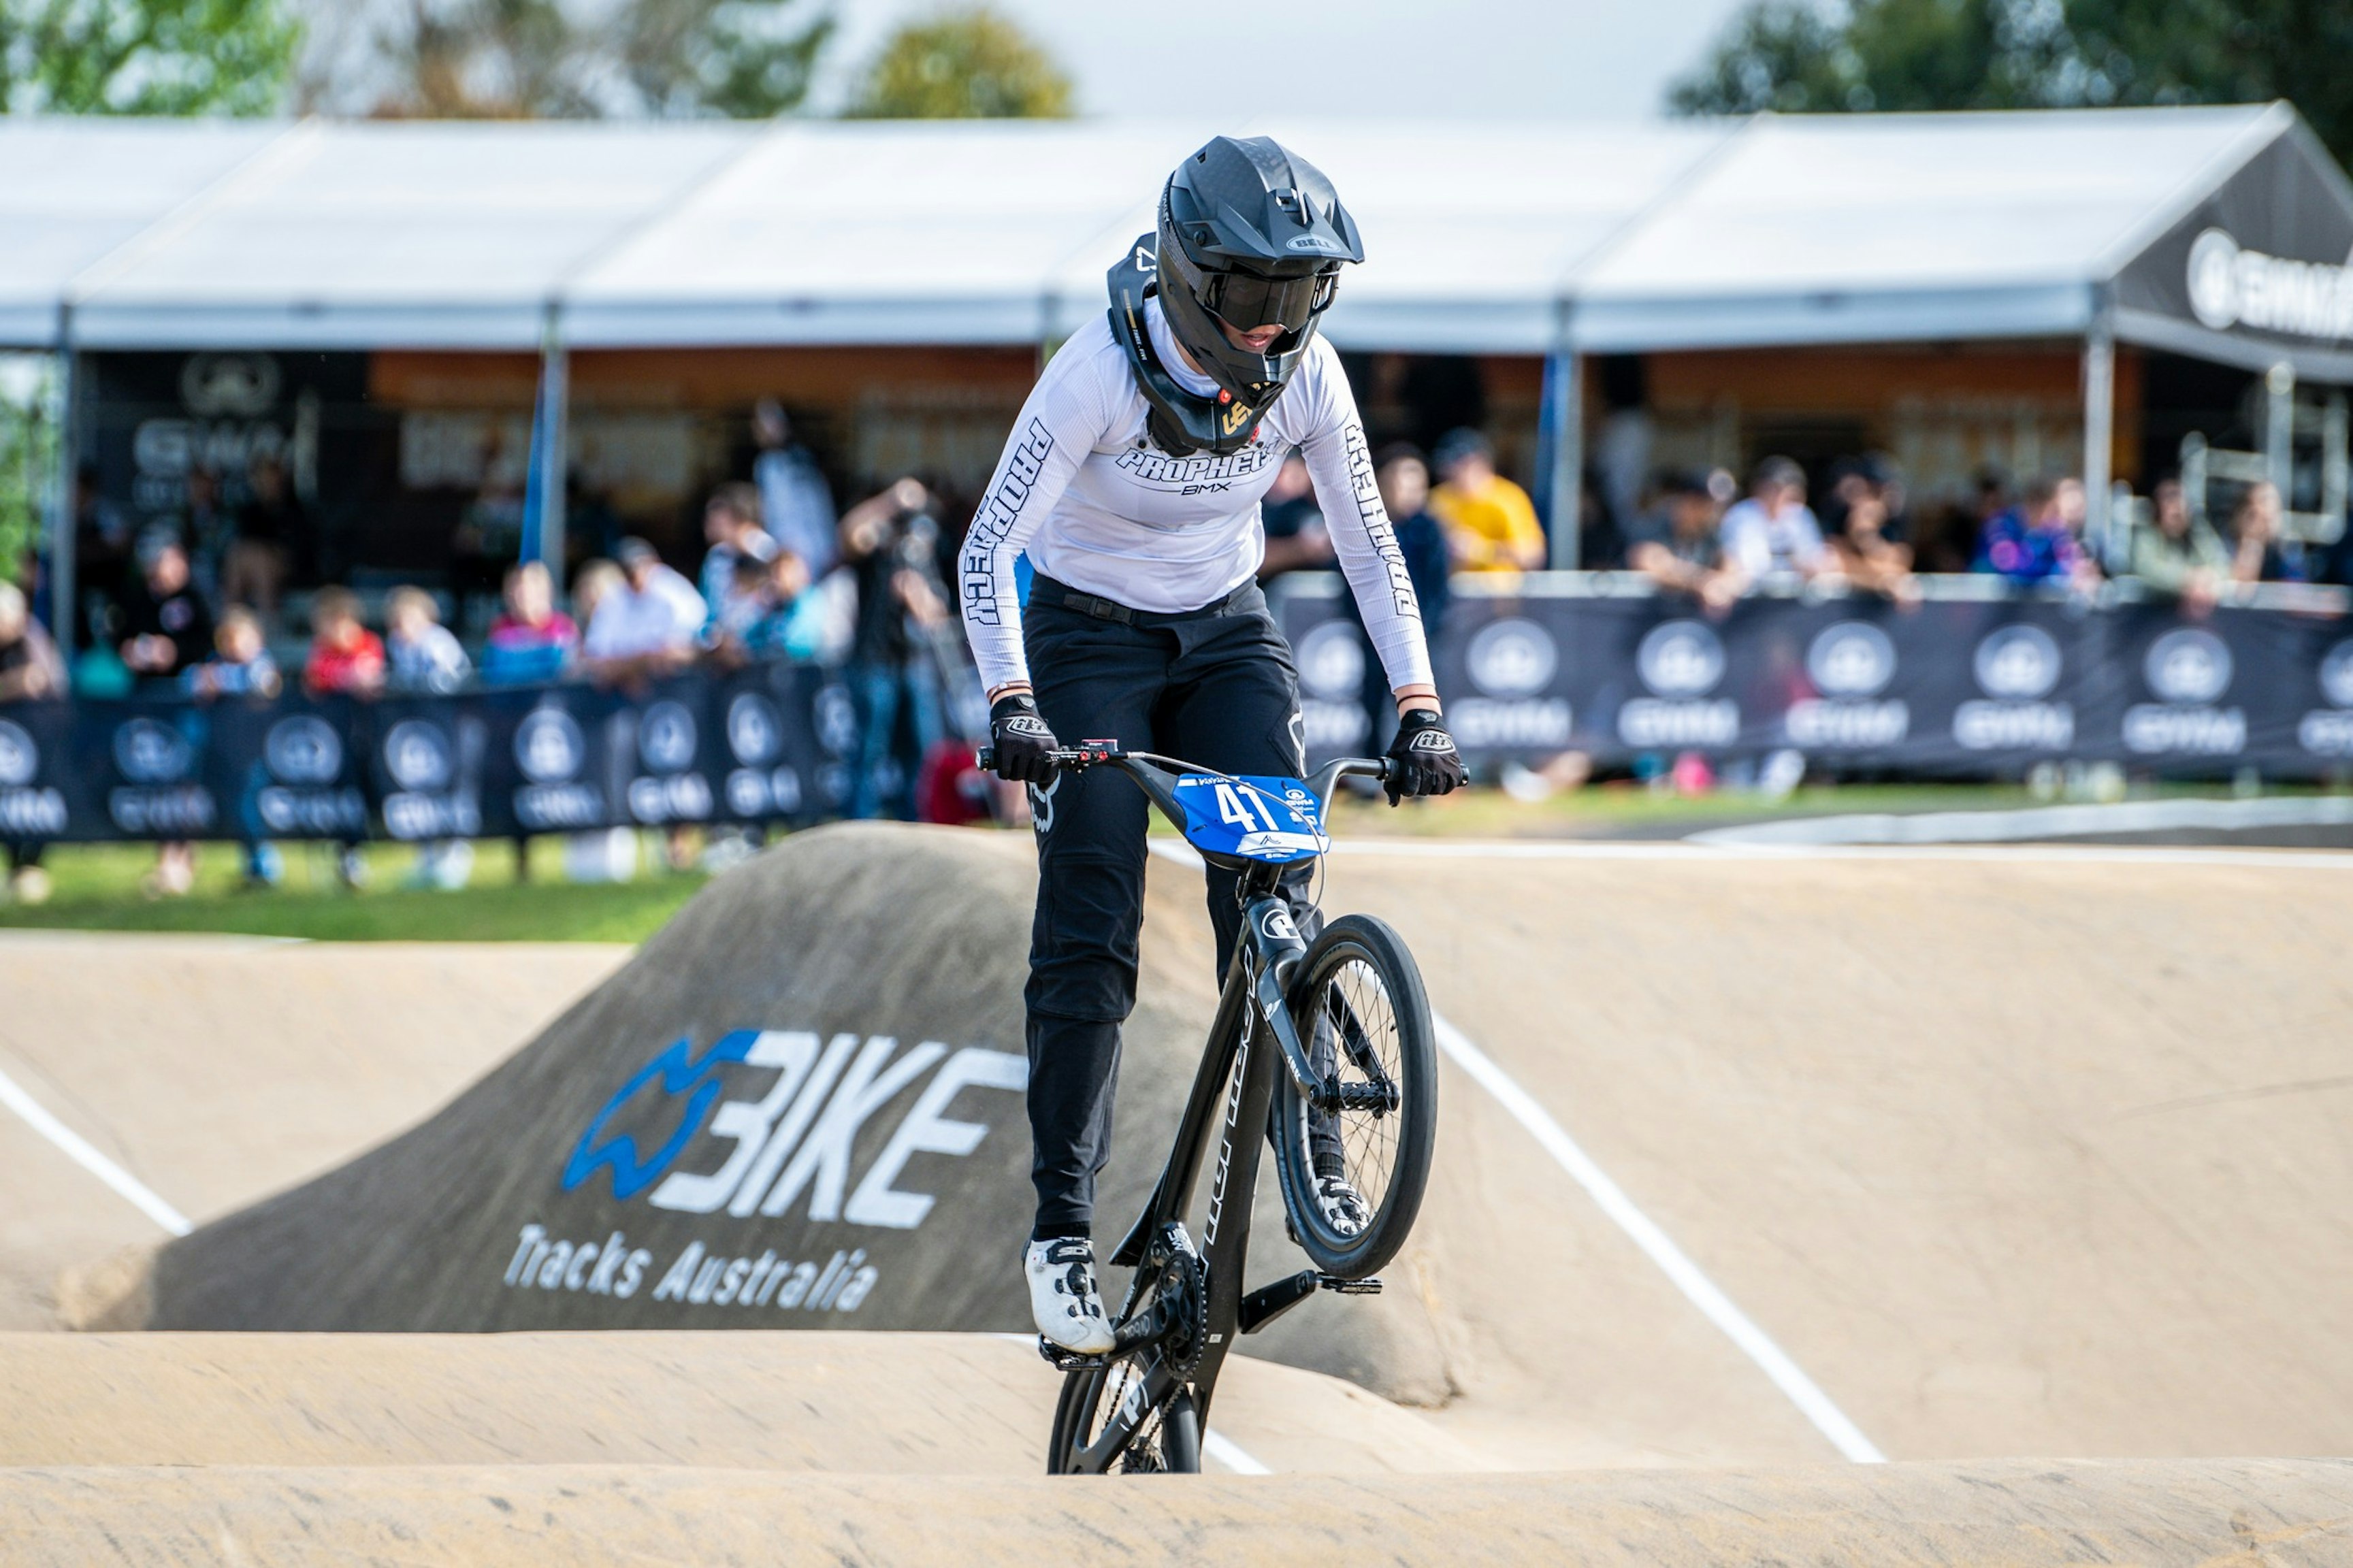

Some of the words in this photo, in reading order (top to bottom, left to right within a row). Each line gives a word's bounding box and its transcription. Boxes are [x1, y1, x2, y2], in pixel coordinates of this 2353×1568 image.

[1295, 238, 1333, 249] BELL
[1181, 482, 1232, 495] BMX
[1215, 782, 1280, 832] 41
[504, 1224, 653, 1299] Tracks
[652, 1239, 879, 1312] Australia
